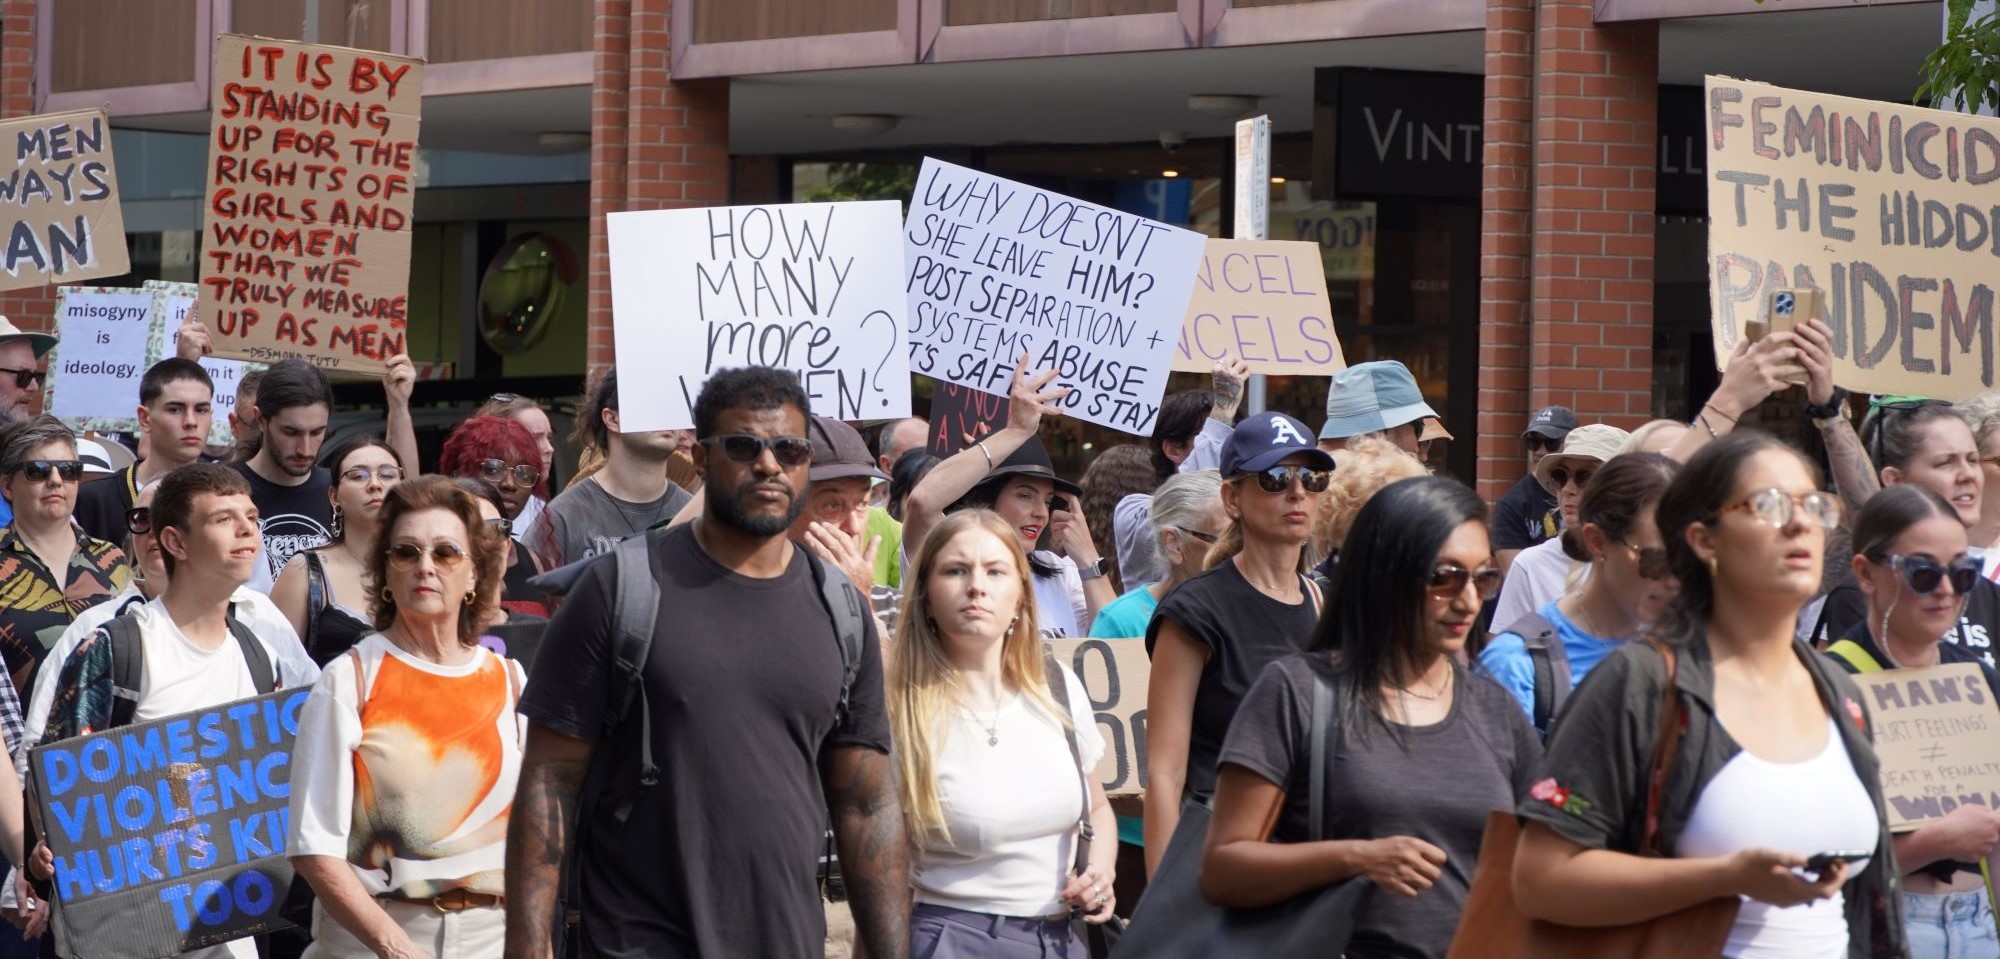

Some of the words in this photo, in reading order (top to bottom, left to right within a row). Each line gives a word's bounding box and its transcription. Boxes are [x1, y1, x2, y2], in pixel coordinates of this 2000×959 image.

[241, 45, 285, 81] IT
[295, 51, 335, 89] IS
[349, 58, 411, 99] BY
[220, 82, 392, 136] STANDING
[17, 117, 103, 165] MEN
[218, 124, 263, 153] UP
[272, 129, 340, 162] FOR
[350, 139, 414, 171] THE
[215, 155, 347, 192] RIGHTS
[356, 173, 410, 200] OF
[211, 187, 321, 226] GIRLS
[329, 199, 405, 231] AND
[924, 167, 1015, 225] WHY
[1018, 192, 1172, 267] DOESN'T
[1716, 170, 1858, 242] THE
[212, 222, 360, 257] WOMEN
[708, 205, 834, 263] HOW
[209, 250, 297, 284] THAT
[304, 258, 363, 286] WE
[909, 213, 973, 260] SHE
[973, 232, 1054, 279] LEAVE
[1066, 255, 1155, 310] HIM?
[68, 303, 147, 321] misogyny
[204, 277, 297, 309] TRULY
[303, 288, 407, 327] MEASURE
[697, 256, 854, 321] MANY
[906, 255, 972, 306] POST
[970, 275, 1137, 349] SEPARATION
[97, 331, 110, 344] is
[217, 308, 260, 339] UP
[276, 313, 317, 347] AS
[329, 322, 403, 361] MEN
[705, 320, 840, 375] more
[908, 301, 1033, 364] SYSTEMS
[1035, 339, 1148, 397] ABUSE
[64, 360, 138, 378] ideology.
[223, 366, 233, 380] it
[1088, 393, 1159, 433] STAY
[1270, 416, 1307, 445] A
[1961, 616, 1990, 648] is
[1870, 675, 1985, 711] MAN'S
[42, 691, 312, 796] DOMESTIC
[1874, 719, 1911, 743] HURT
[1915, 715, 1988, 738] FEELINGS
[1938, 762, 2000, 780] PENALTY
[53, 824, 218, 902] HURTS
[159, 869, 274, 933] TOO
